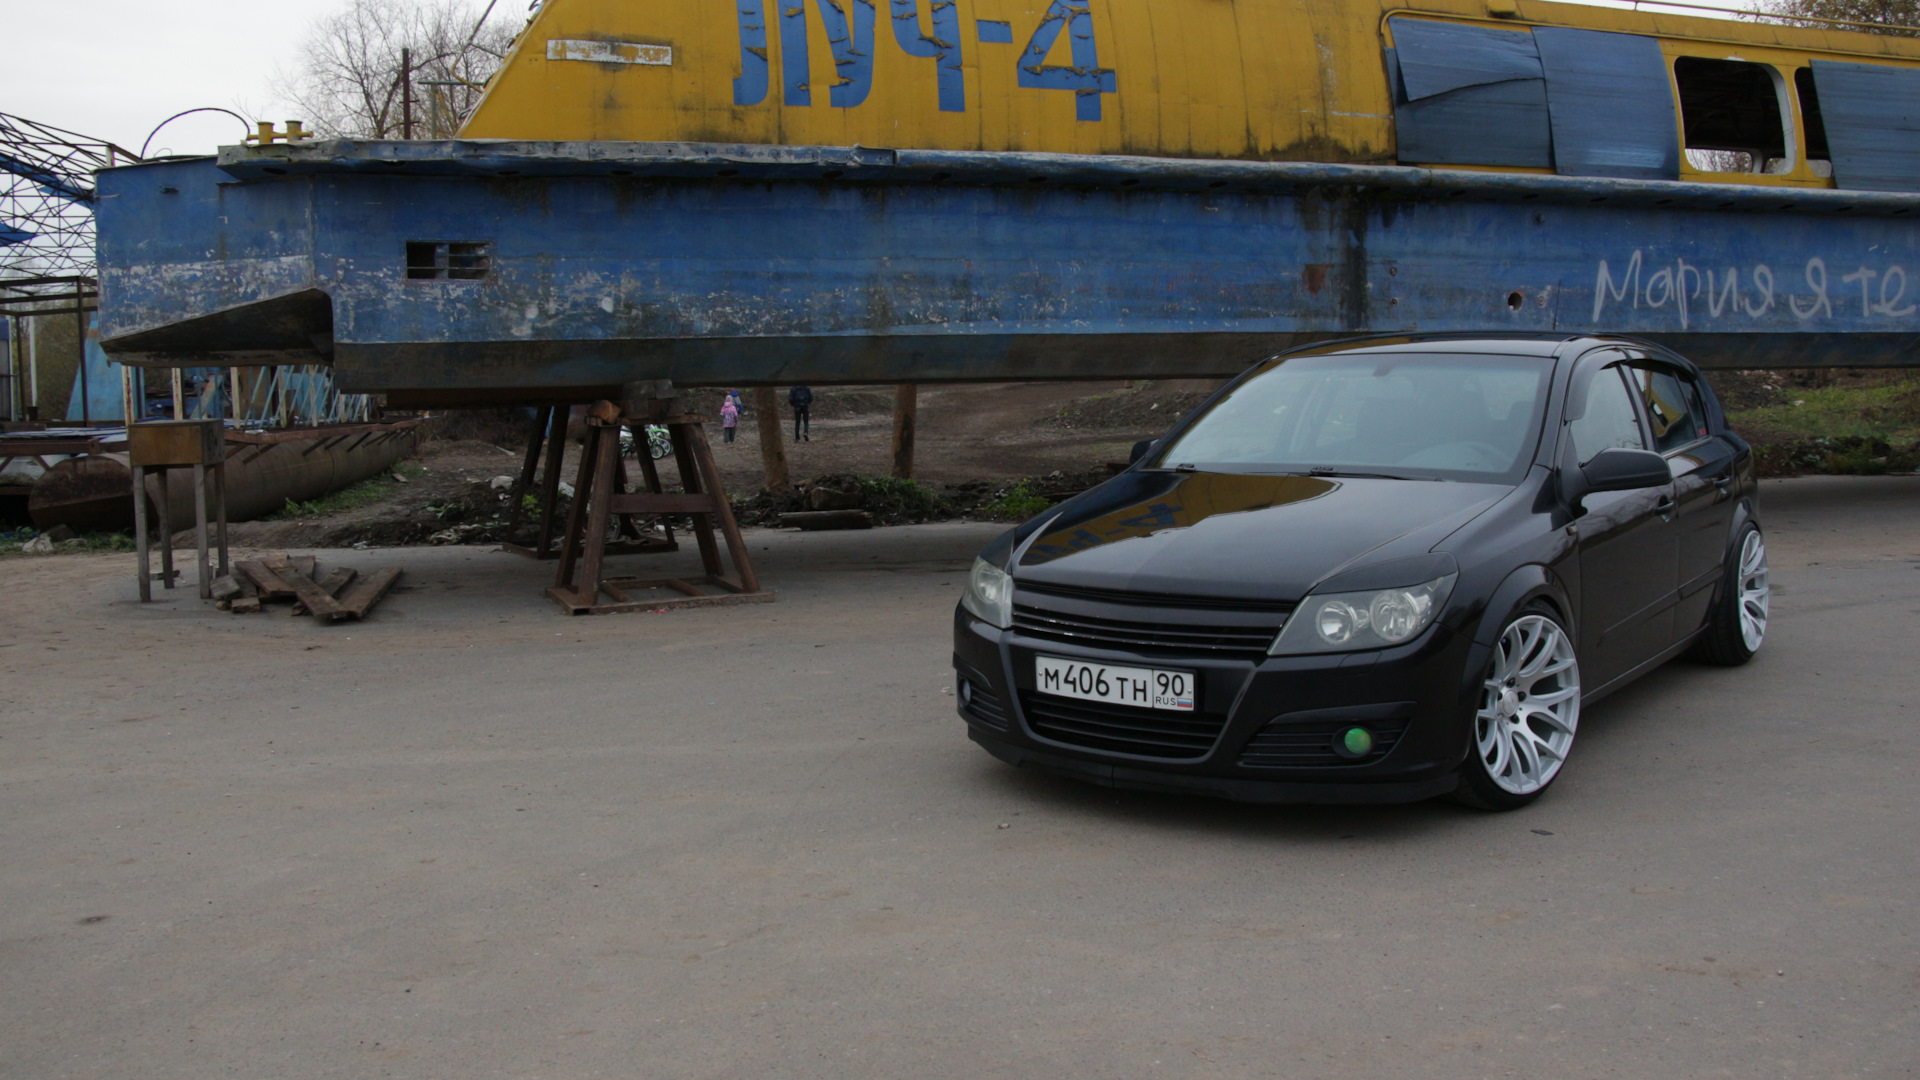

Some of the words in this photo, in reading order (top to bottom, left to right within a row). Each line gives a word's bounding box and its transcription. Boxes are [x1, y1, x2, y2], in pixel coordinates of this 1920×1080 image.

[1592, 250, 1776, 330] Мария
[1156, 672, 1185, 697] 90
[1155, 696, 1177, 706] RUS
